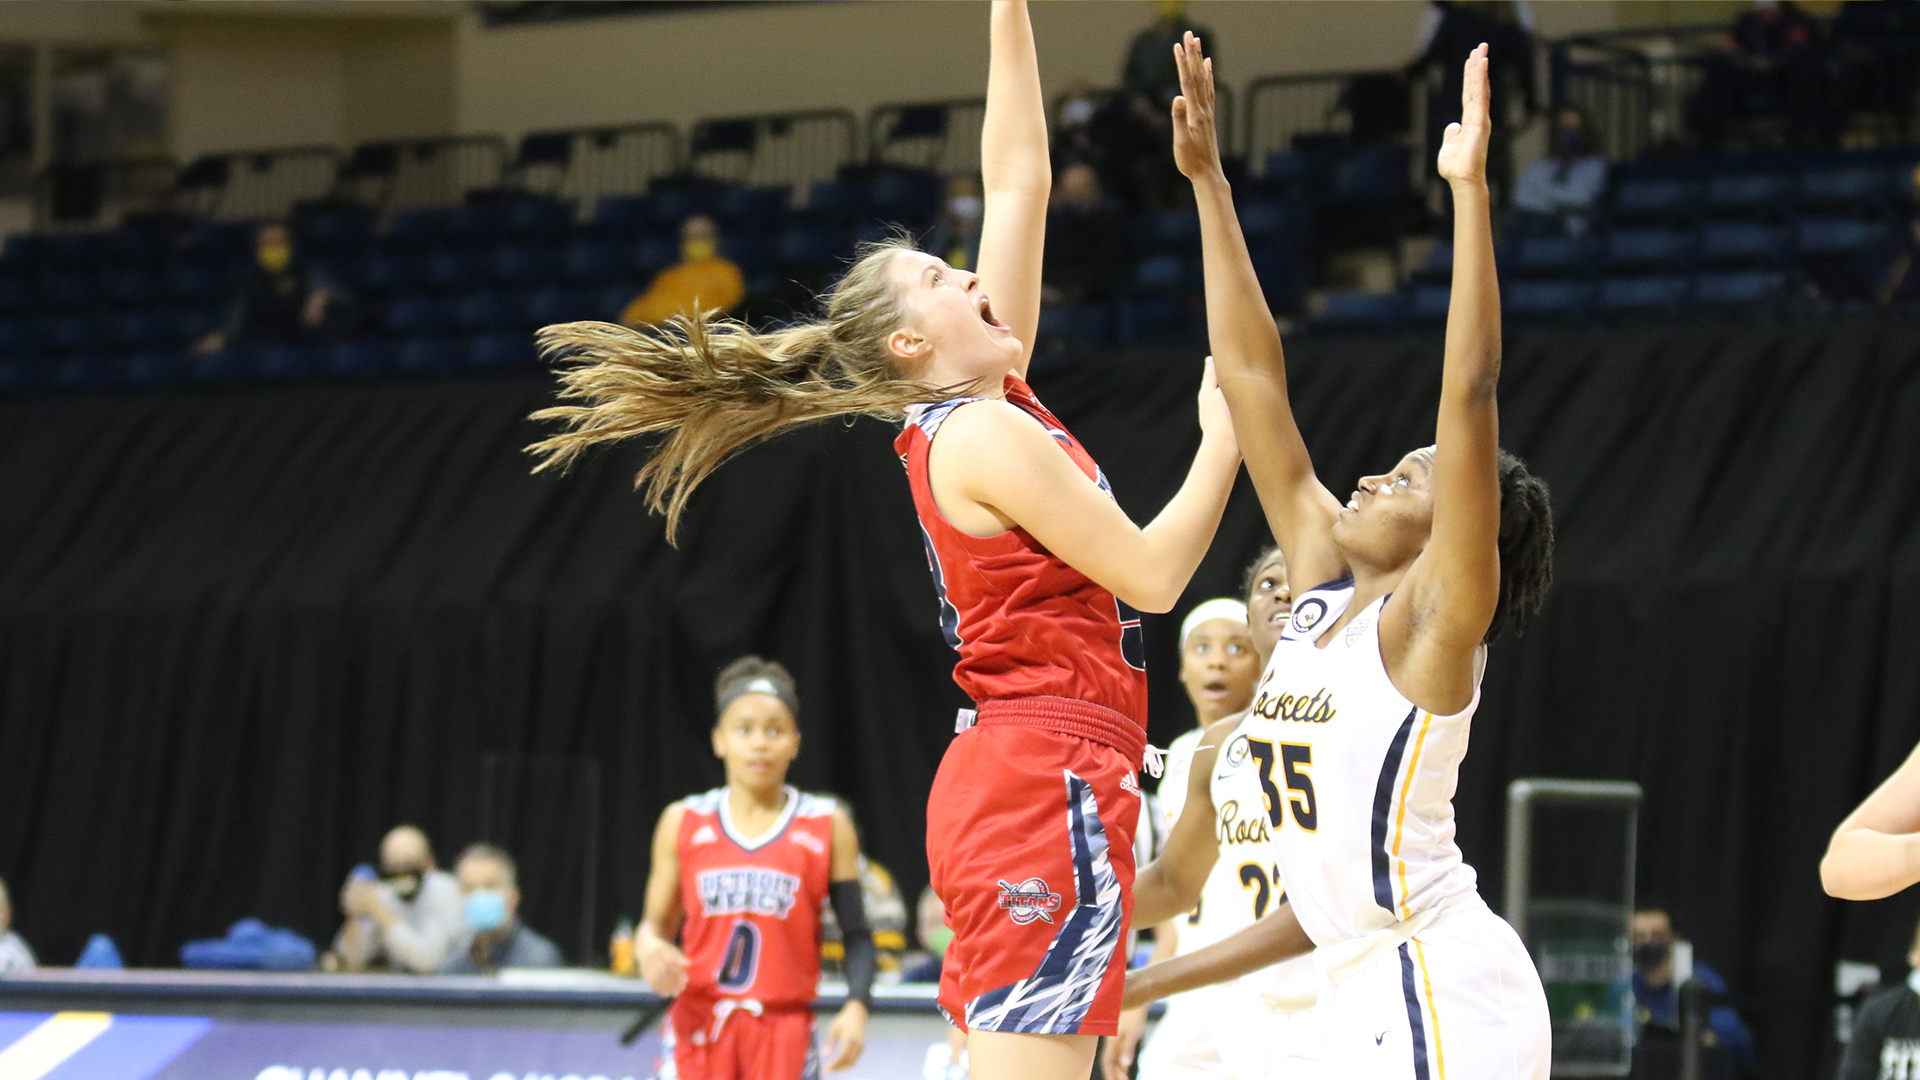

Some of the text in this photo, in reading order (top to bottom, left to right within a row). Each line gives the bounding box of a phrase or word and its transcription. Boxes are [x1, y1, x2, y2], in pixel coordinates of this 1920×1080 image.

[1247, 735, 1318, 833] 35
[697, 867, 800, 895] DETROIT
[702, 891, 796, 920] MERCY
[1000, 893, 1059, 909] TITANS
